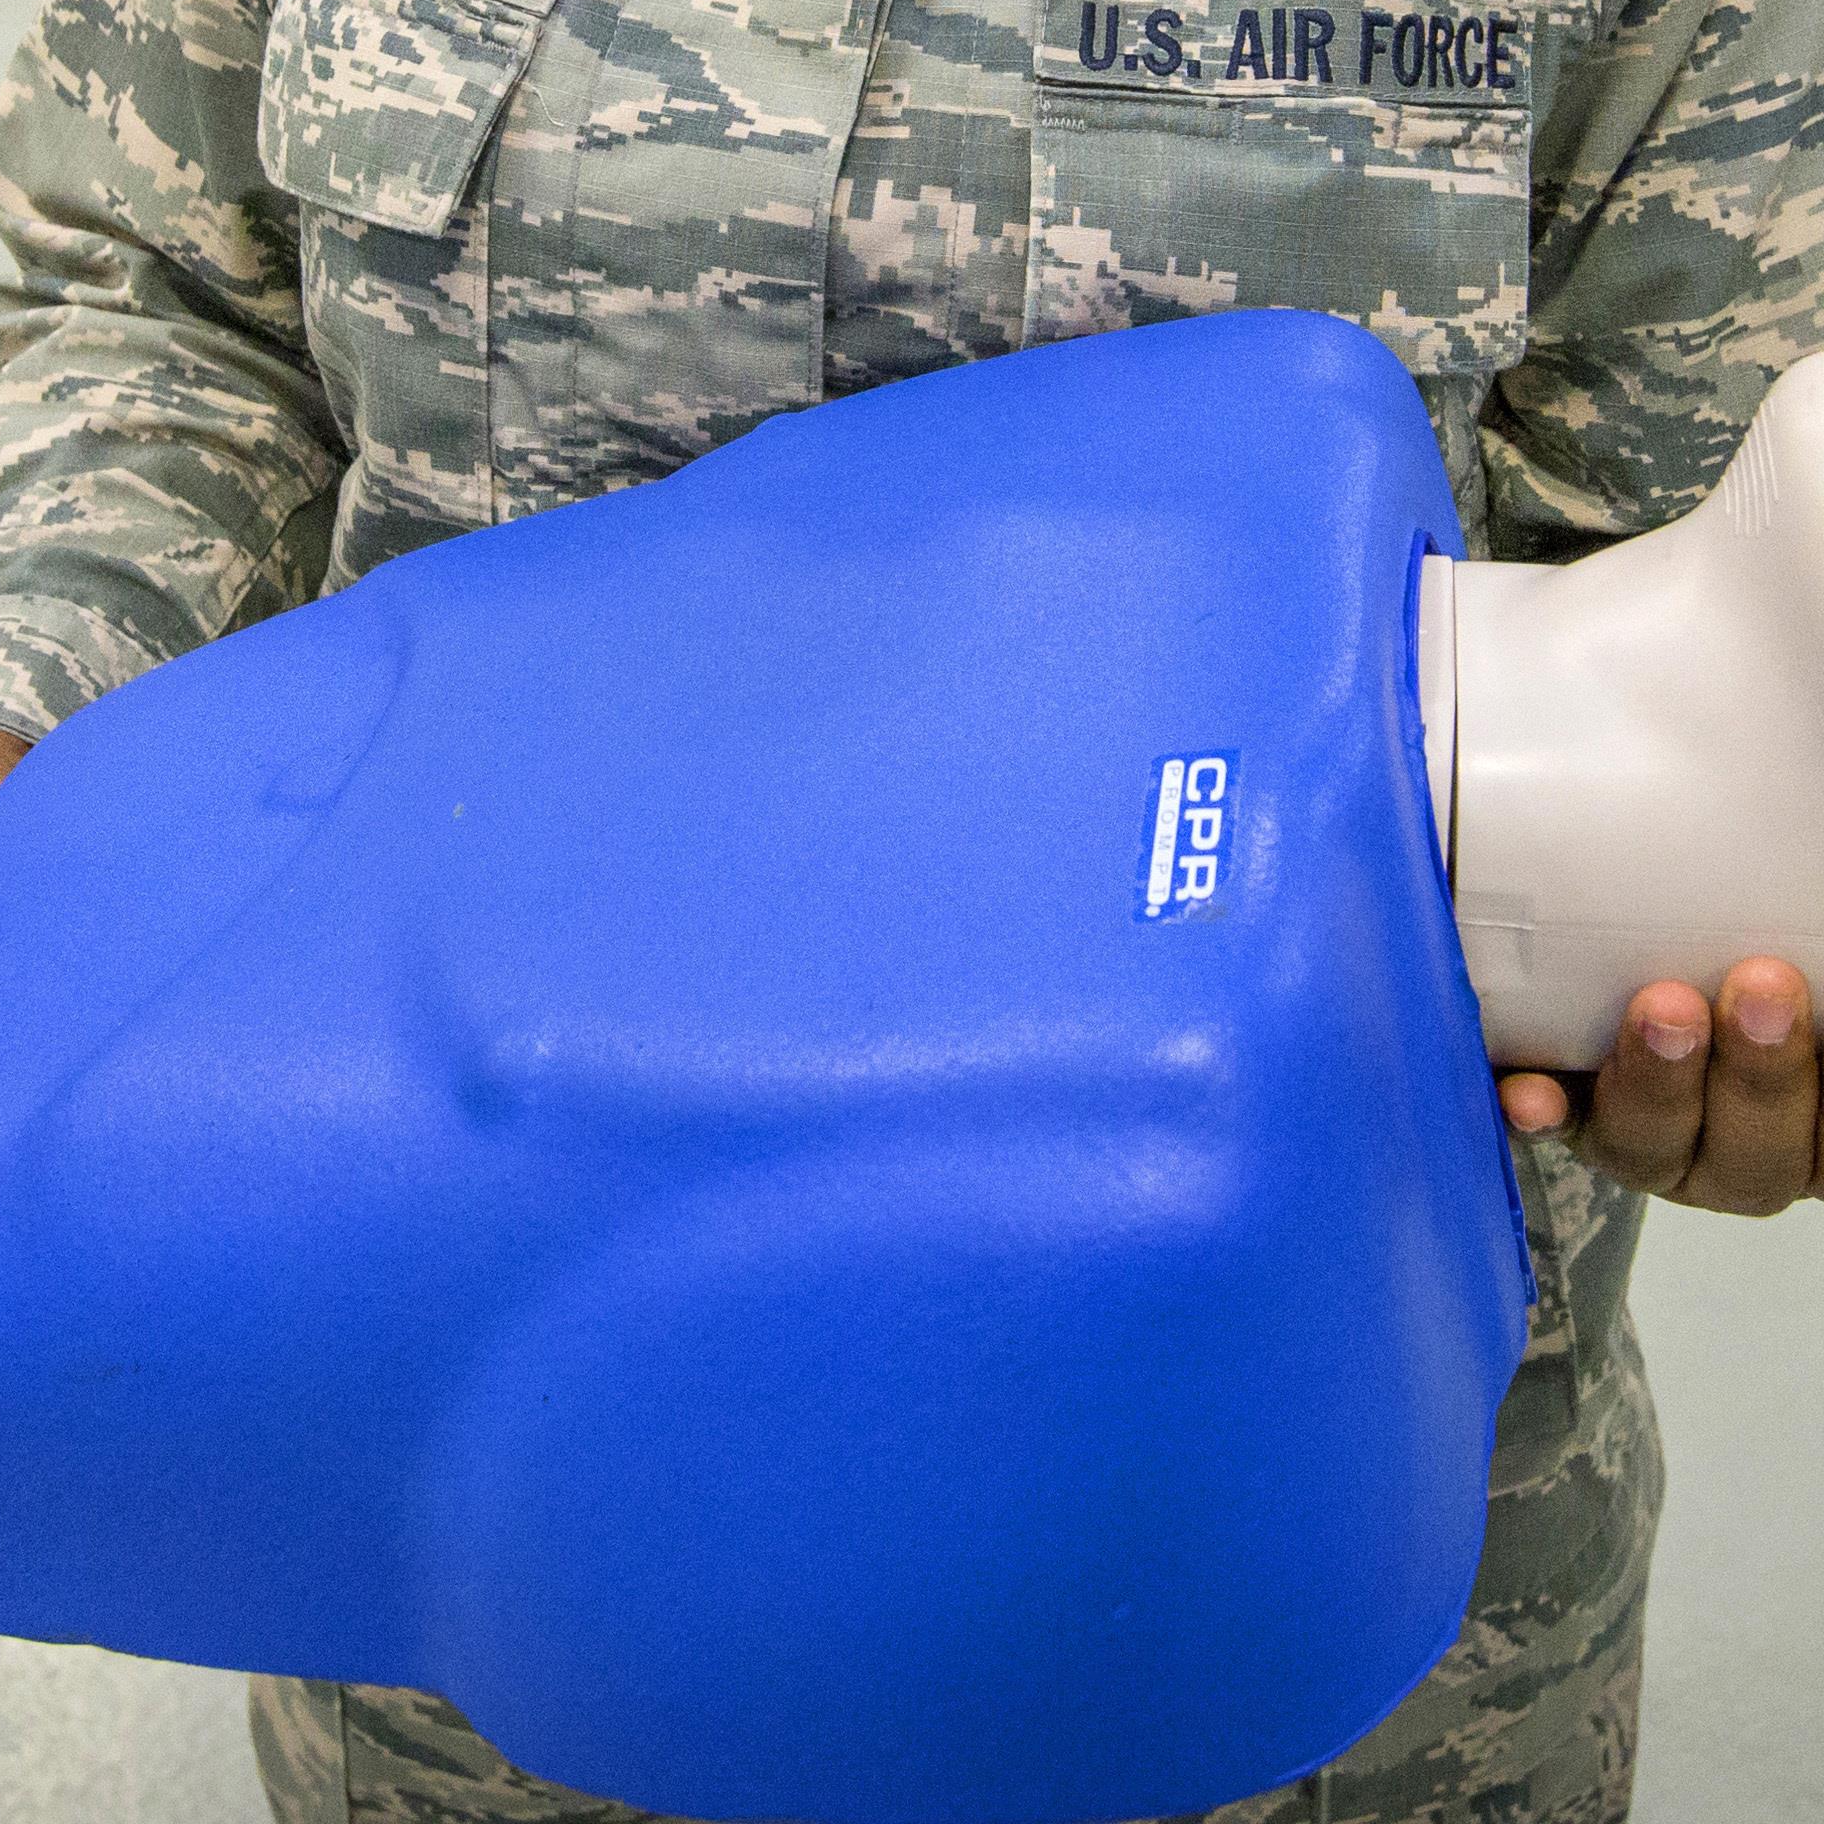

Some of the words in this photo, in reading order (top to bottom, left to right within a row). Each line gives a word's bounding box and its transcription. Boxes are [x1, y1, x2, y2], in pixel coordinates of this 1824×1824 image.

[1078, 1, 1202, 77] U.S.
[1225, 8, 1336, 83] AIR
[1359, 10, 1519, 90] FORCE
[1151, 764, 1182, 897] PROMPT
[1175, 757, 1227, 902] CPR
